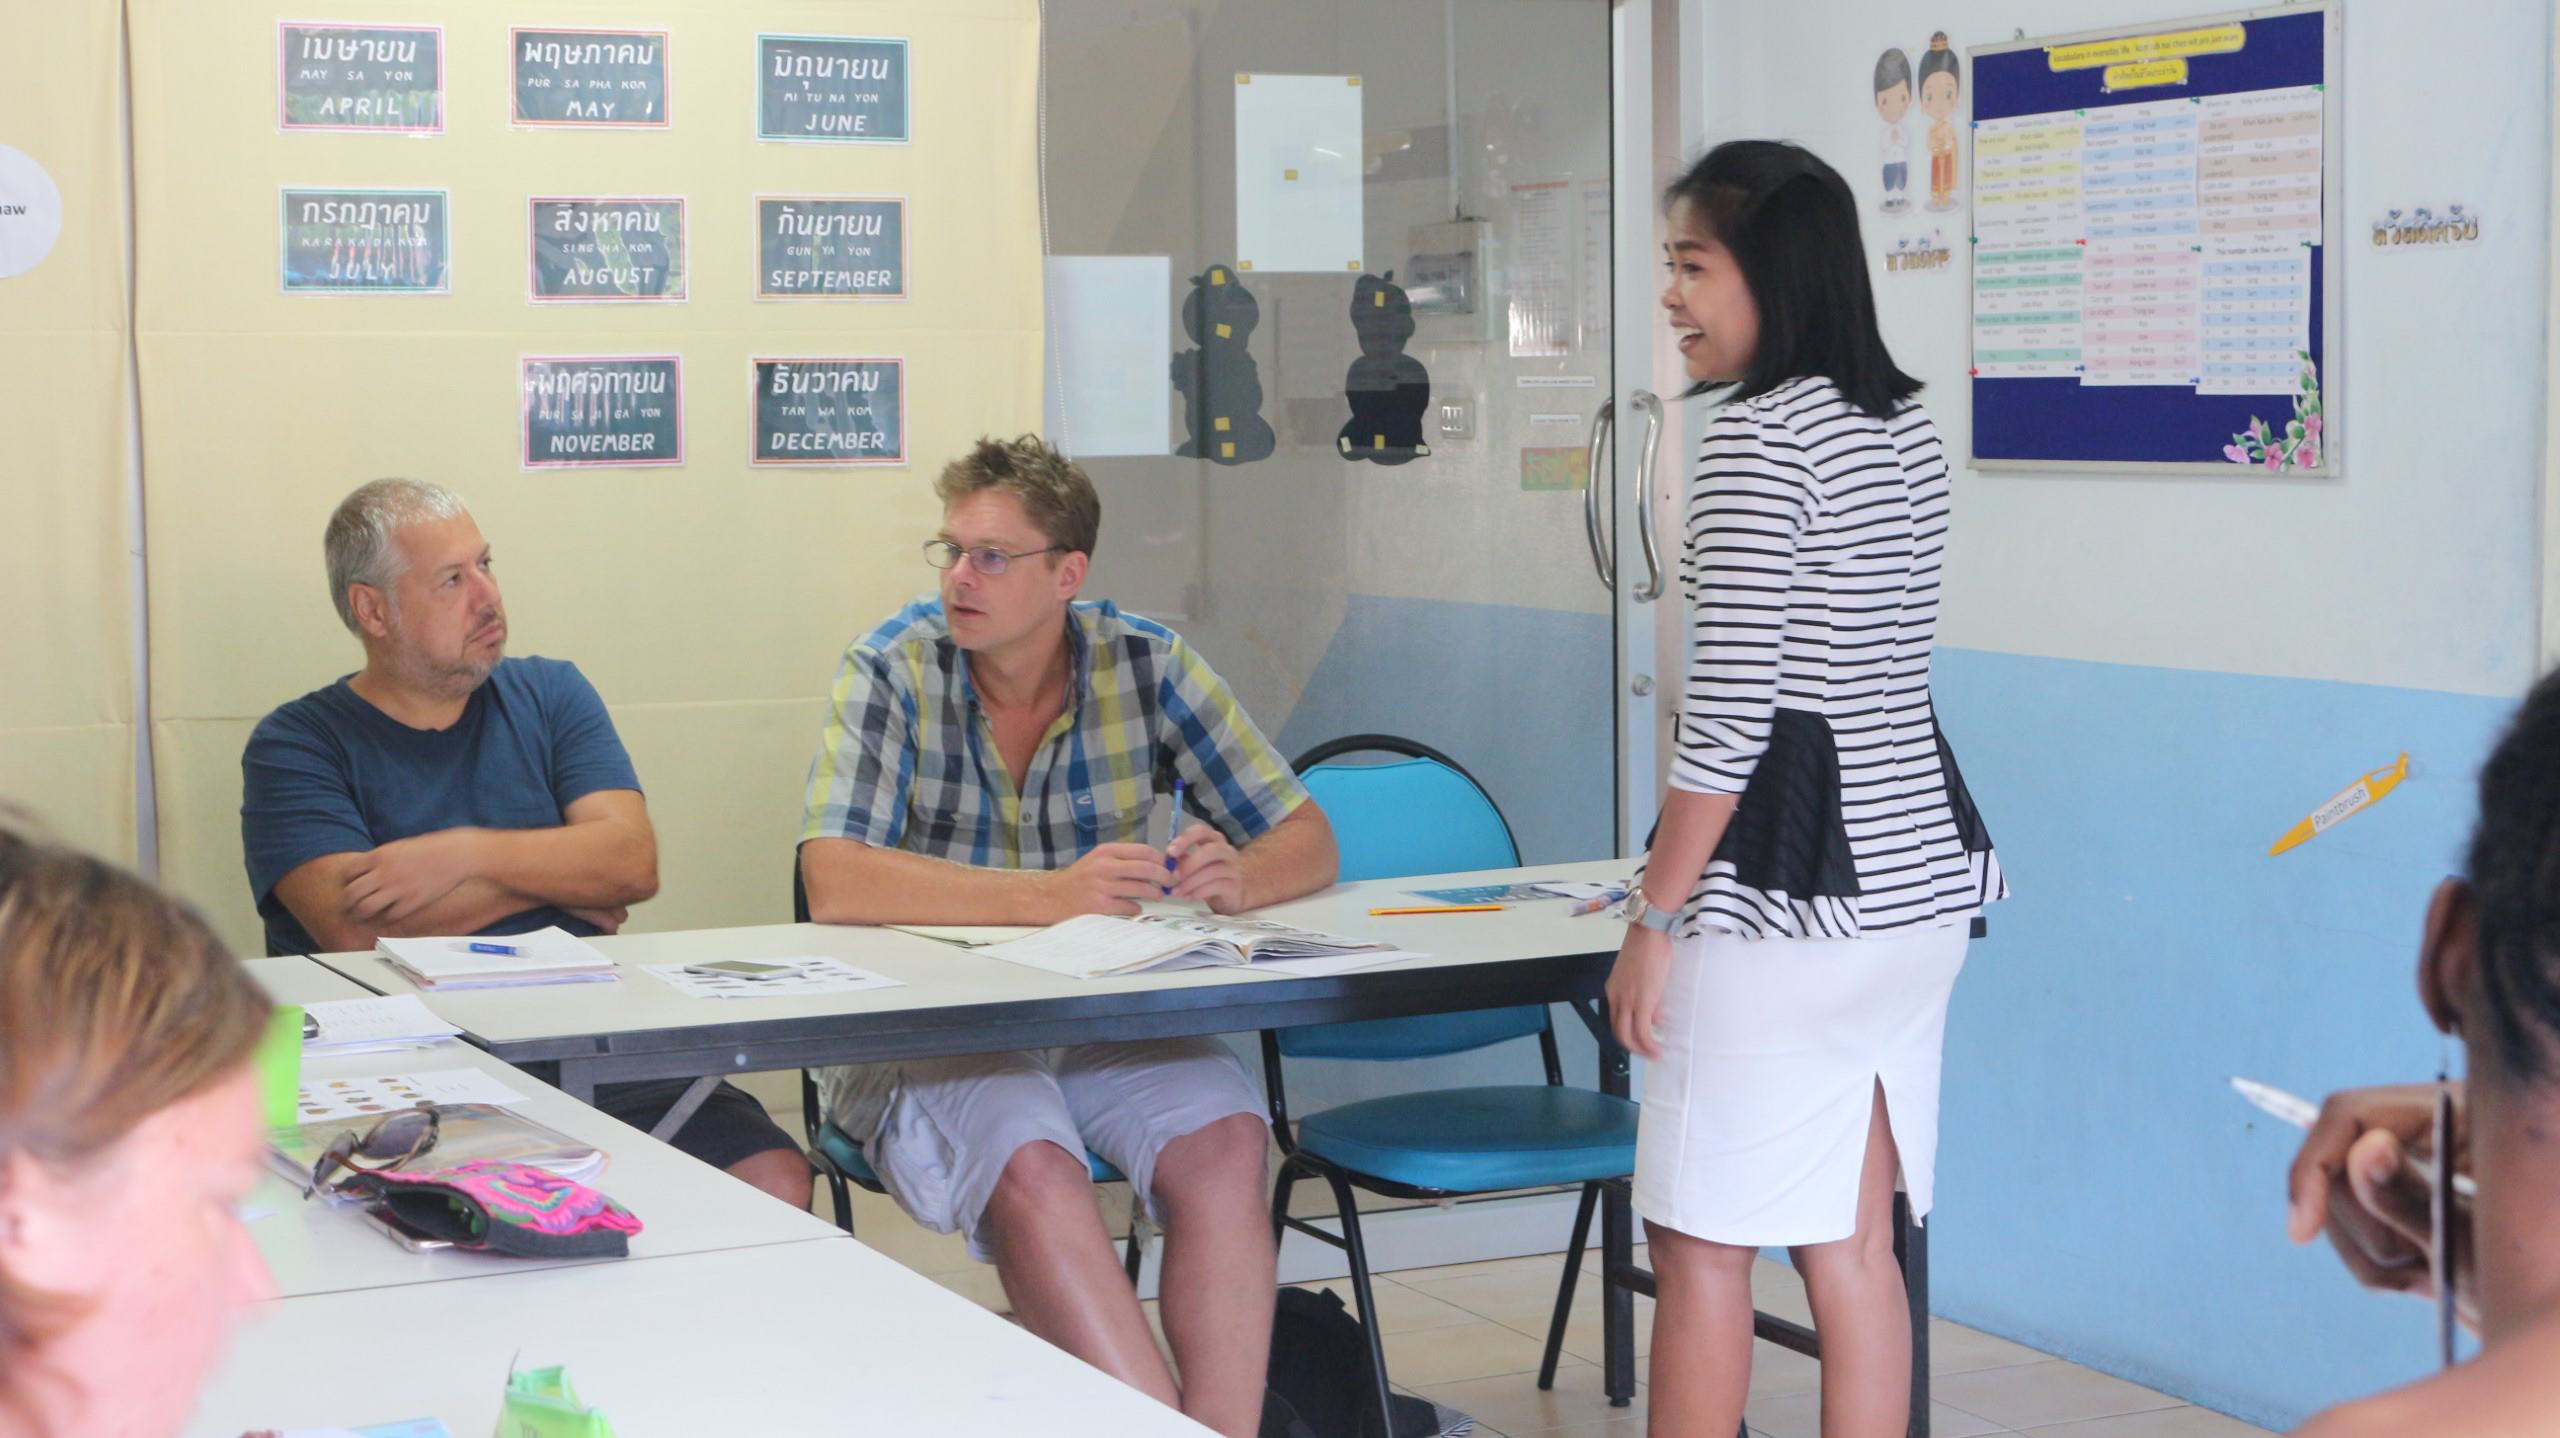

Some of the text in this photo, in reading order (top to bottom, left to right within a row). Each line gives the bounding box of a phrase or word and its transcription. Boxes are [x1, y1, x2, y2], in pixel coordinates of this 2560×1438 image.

[302, 37, 417, 63] เมษายน
[524, 41, 654, 70] พฤษภาคม
[300, 69, 413, 81] MAY SA YON
[773, 49, 889, 91] มิถุนายน
[527, 77, 647, 90] PUR SA PHA KOM
[319, 96, 400, 115] APRIL
[783, 92, 879, 104] MI TU NA YON
[565, 100, 616, 118] MAY
[805, 113, 868, 132] JUNE
[302, 202, 431, 230] กรกฎาคม
[554, 203, 661, 233] สิงหาคม
[777, 205, 883, 236] กันยายน
[562, 243, 595, 253] SING
[629, 243, 653, 253] KOM
[786, 246, 872, 257] GUN YA YON
[328, 262, 396, 281] JULY
[563, 266, 655, 285] AUGUST
[770, 269, 892, 288] SEPTEMBER
[537, 367, 666, 401] พฤศจิกายน
[772, 363, 880, 394] ธันวาคม
[613, 409, 630, 420] GA
[640, 407, 661, 418] YON
[781, 406, 873, 417] TAN WA KOM
[550, 432, 656, 453] NOVEMBER
[770, 431, 885, 451] DECEMBER
[2313, 787, 2367, 827] Paintbrush
